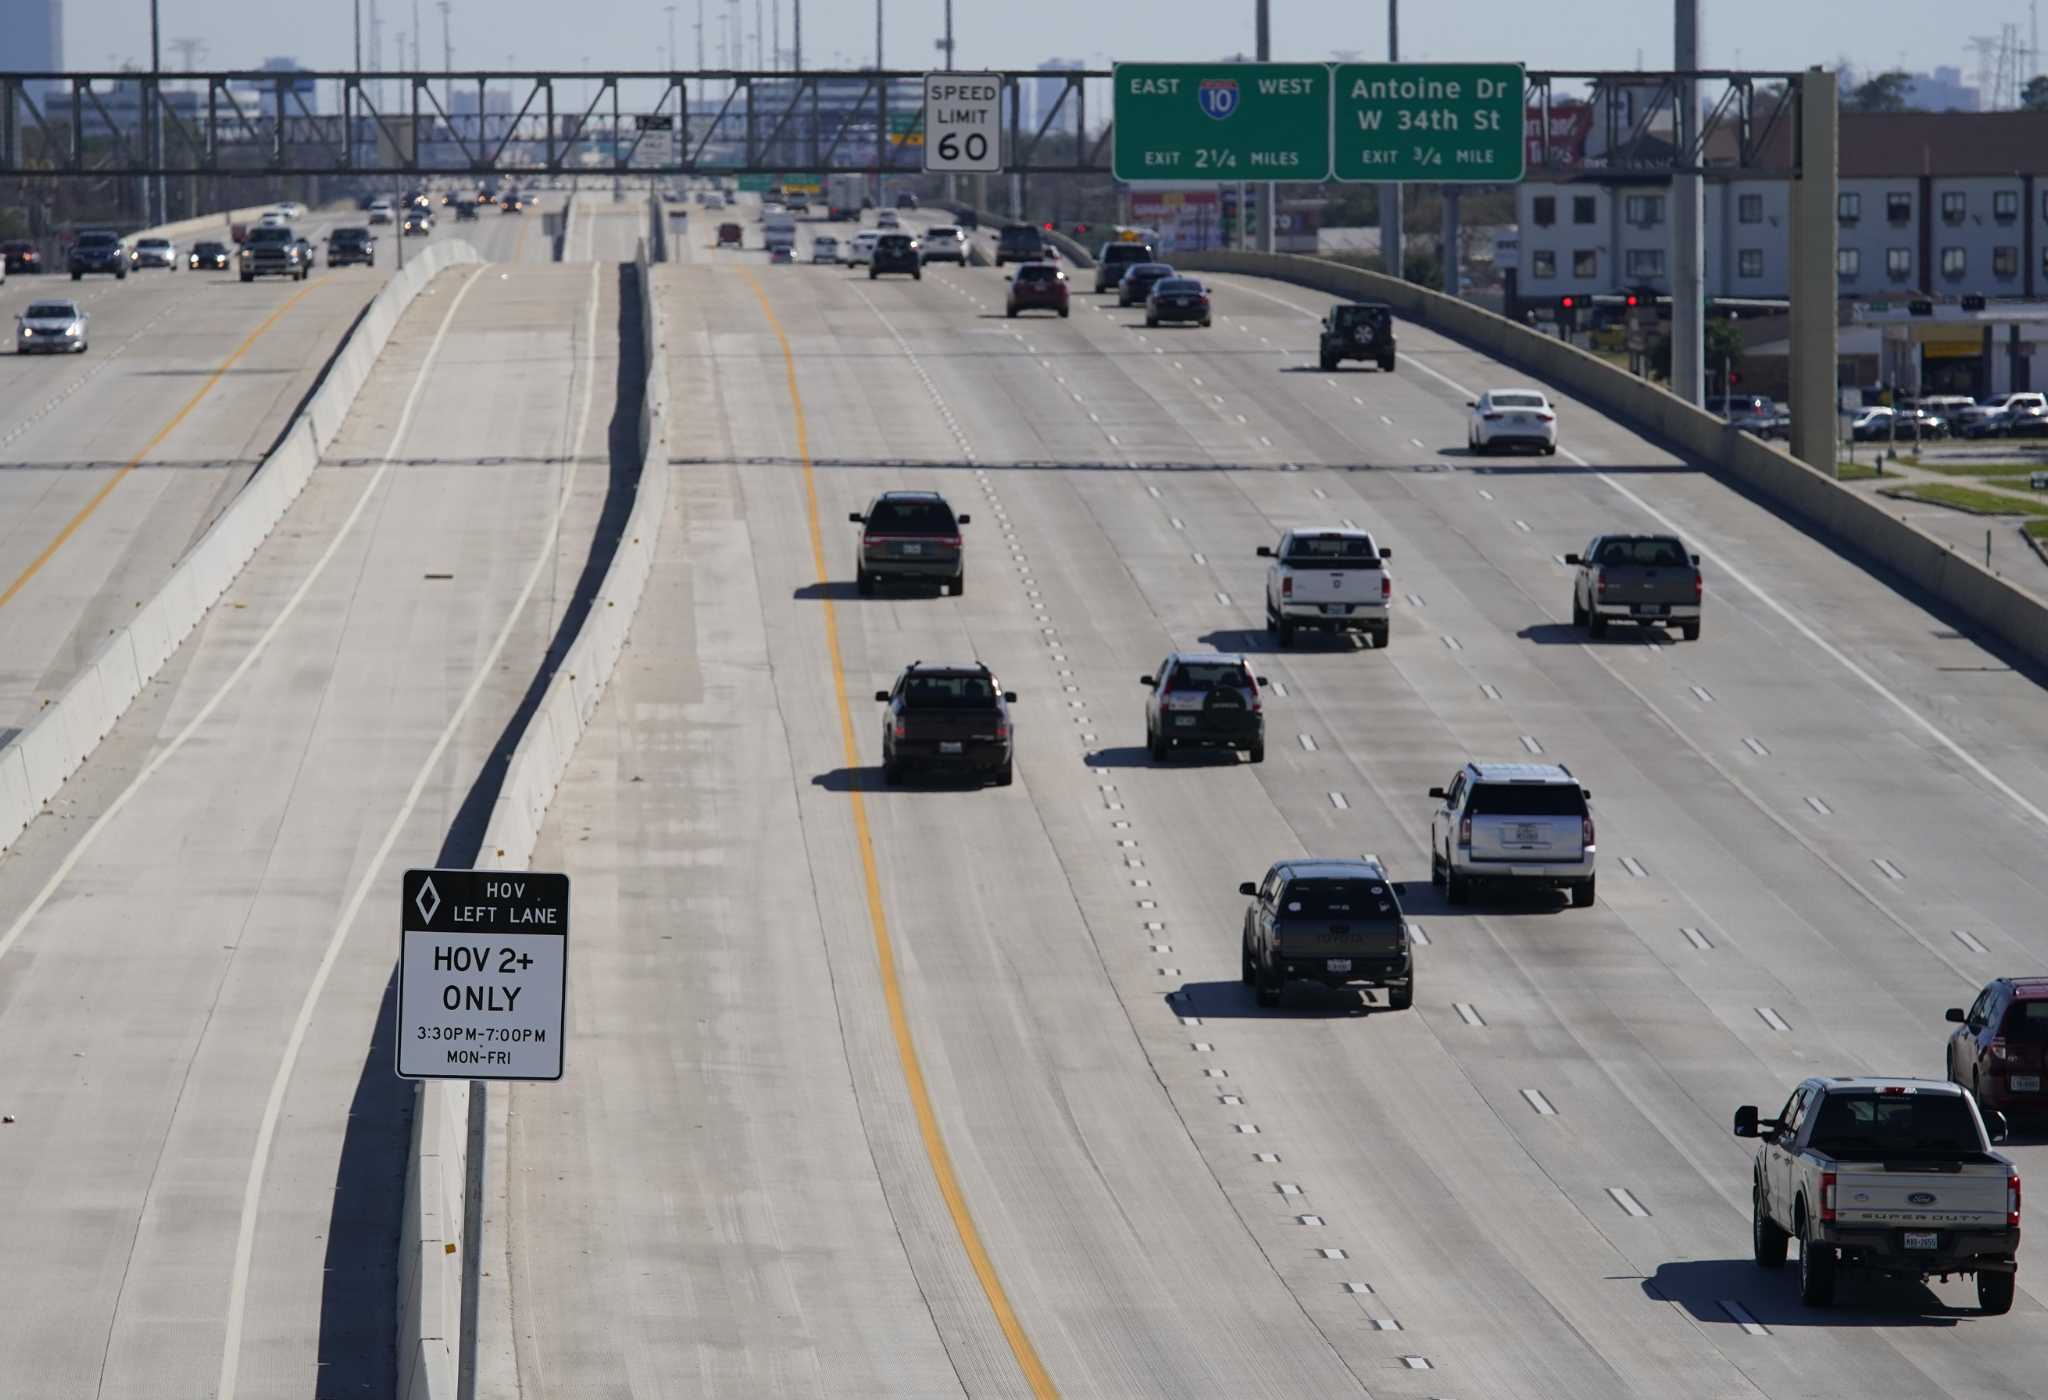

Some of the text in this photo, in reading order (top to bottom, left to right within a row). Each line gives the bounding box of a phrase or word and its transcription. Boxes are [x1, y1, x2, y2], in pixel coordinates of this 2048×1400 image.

[931, 85, 996, 101] SPEED
[1130, 78, 1180, 95] EAST
[1258, 78, 1314, 95] WEST
[1351, 77, 1508, 99] Antoine Dr
[1208, 88, 1232, 112] 10
[937, 109, 988, 124] LIMIT
[1358, 110, 1382, 131] W
[1397, 109, 1458, 131] 34th
[1473, 109, 1500, 131] St
[938, 132, 987, 161] 60
[1145, 151, 1181, 166] EXIT
[1251, 151, 1299, 166] MILES
[1362, 149, 1398, 164] EXIT
[1456, 149, 1494, 164] MILE
[486, 882, 526, 899] HOV
[453, 906, 557, 924] LEFT LANE
[433, 946, 534, 974] HOV 2+
[442, 985, 522, 1012] ONLY
[417, 1026, 546, 1043] 3:30PM-7:00PM
[446, 1050, 511, 1065] MON-FRI
[1861, 1212, 1927, 1221] SUPER
